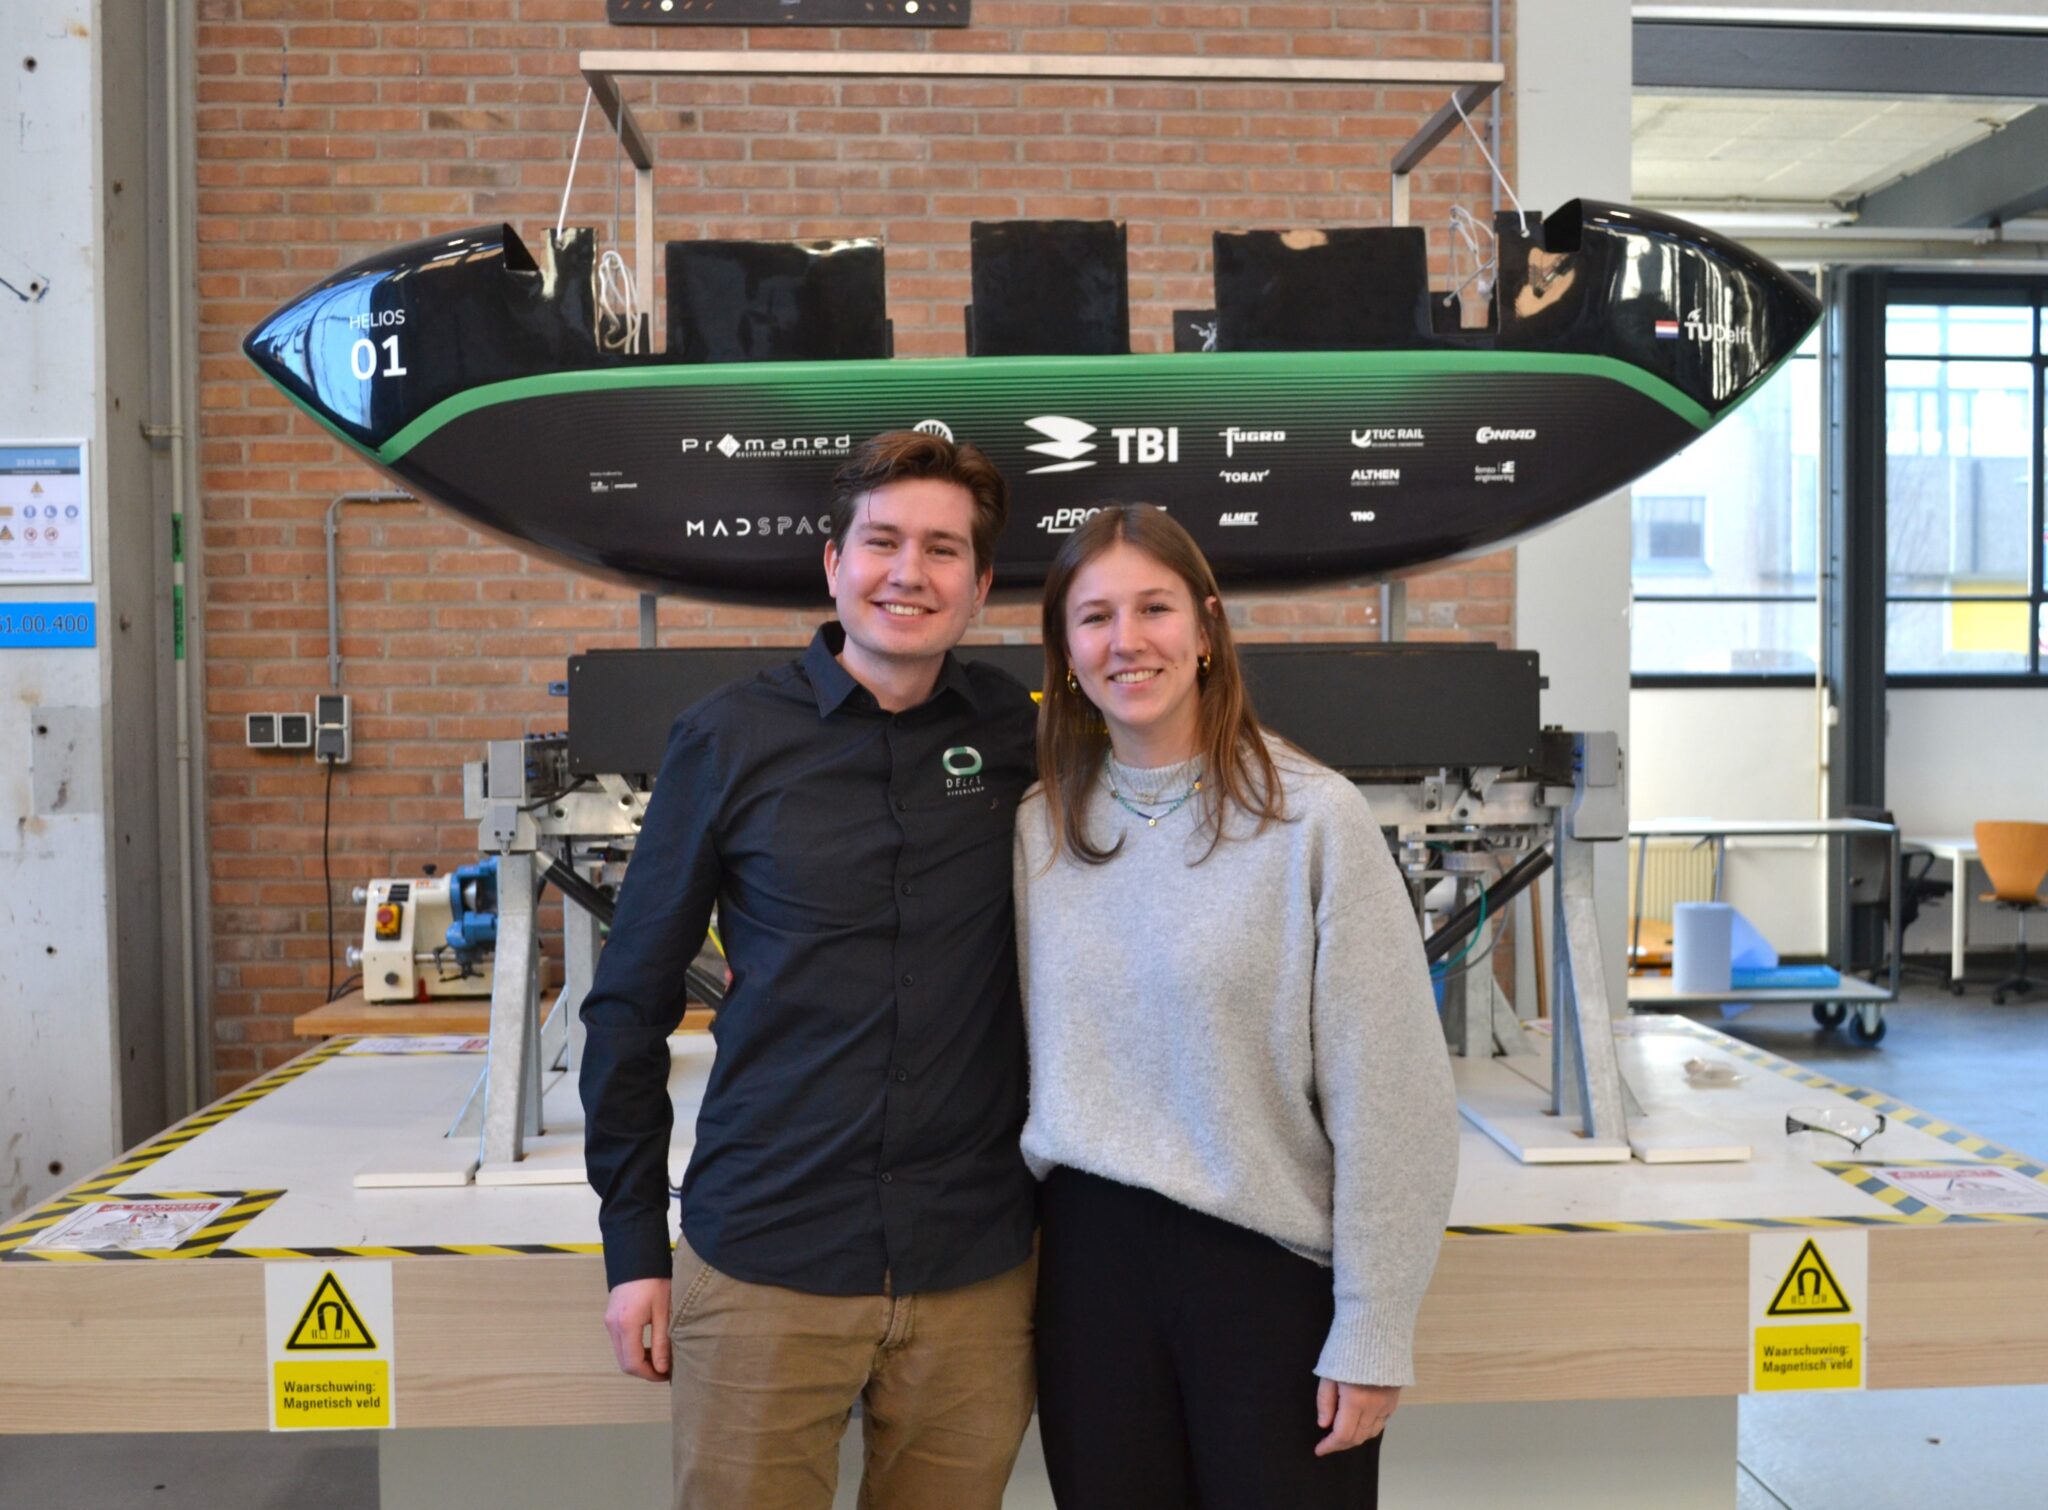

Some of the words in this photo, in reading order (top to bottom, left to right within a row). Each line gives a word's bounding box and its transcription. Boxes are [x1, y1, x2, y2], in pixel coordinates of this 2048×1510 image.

[349, 308, 406, 329] HELIOS
[350, 334, 408, 381] 01
[1372, 428, 1396, 440] TUC
[1397, 428, 1424, 439] RAIL
[1111, 426, 1179, 464] TBI
[783, 449, 815, 457] PROJECT
[818, 448, 850, 456] INSIGHT
[1351, 469, 1400, 480] ALTHEN
[1219, 511, 1259, 523] ALMET
[1350, 511, 1376, 522] TNO
[686, 515, 832, 537] MADSPAC
[0, 614, 88, 634] 1.00.400
[1763, 1344, 1849, 1357] Waarschuwing:
[1762, 1360, 1827, 1374] Magnetisch
[1829, 1359, 1853, 1370] veld
[284, 1381, 376, 1394] Waarschuwing:
[283, 1397, 352, 1411] Magnetisch
[356, 1397, 381, 1408] veld
